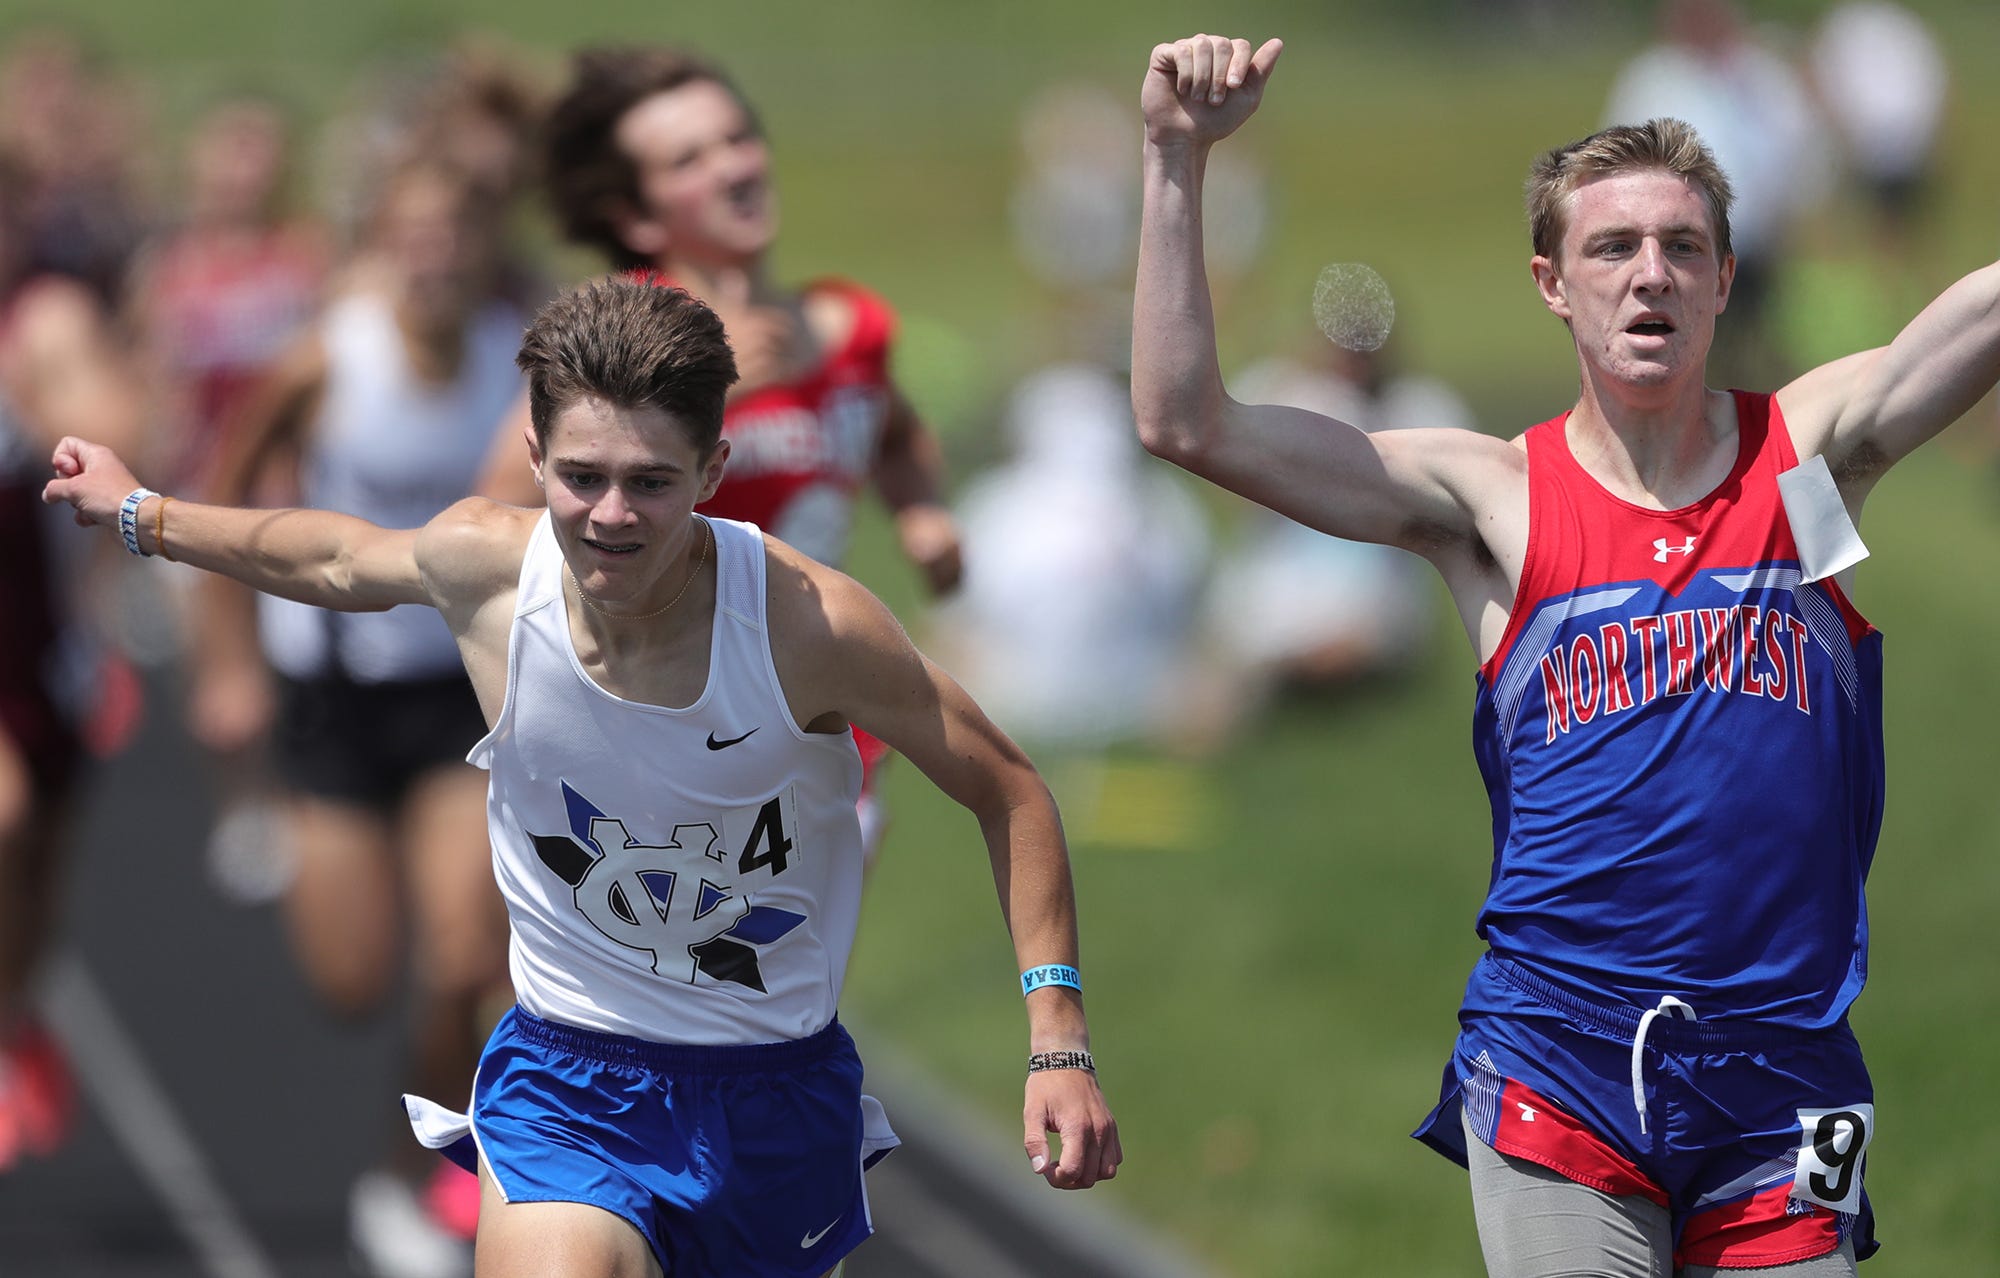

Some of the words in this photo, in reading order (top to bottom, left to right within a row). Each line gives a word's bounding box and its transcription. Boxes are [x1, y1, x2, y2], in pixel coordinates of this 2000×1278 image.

[1539, 603, 1811, 746] NORTHWEST
[737, 796, 793, 877] 4
[1024, 967, 1078, 988] OHSAA
[1808, 1110, 1866, 1203] 9
